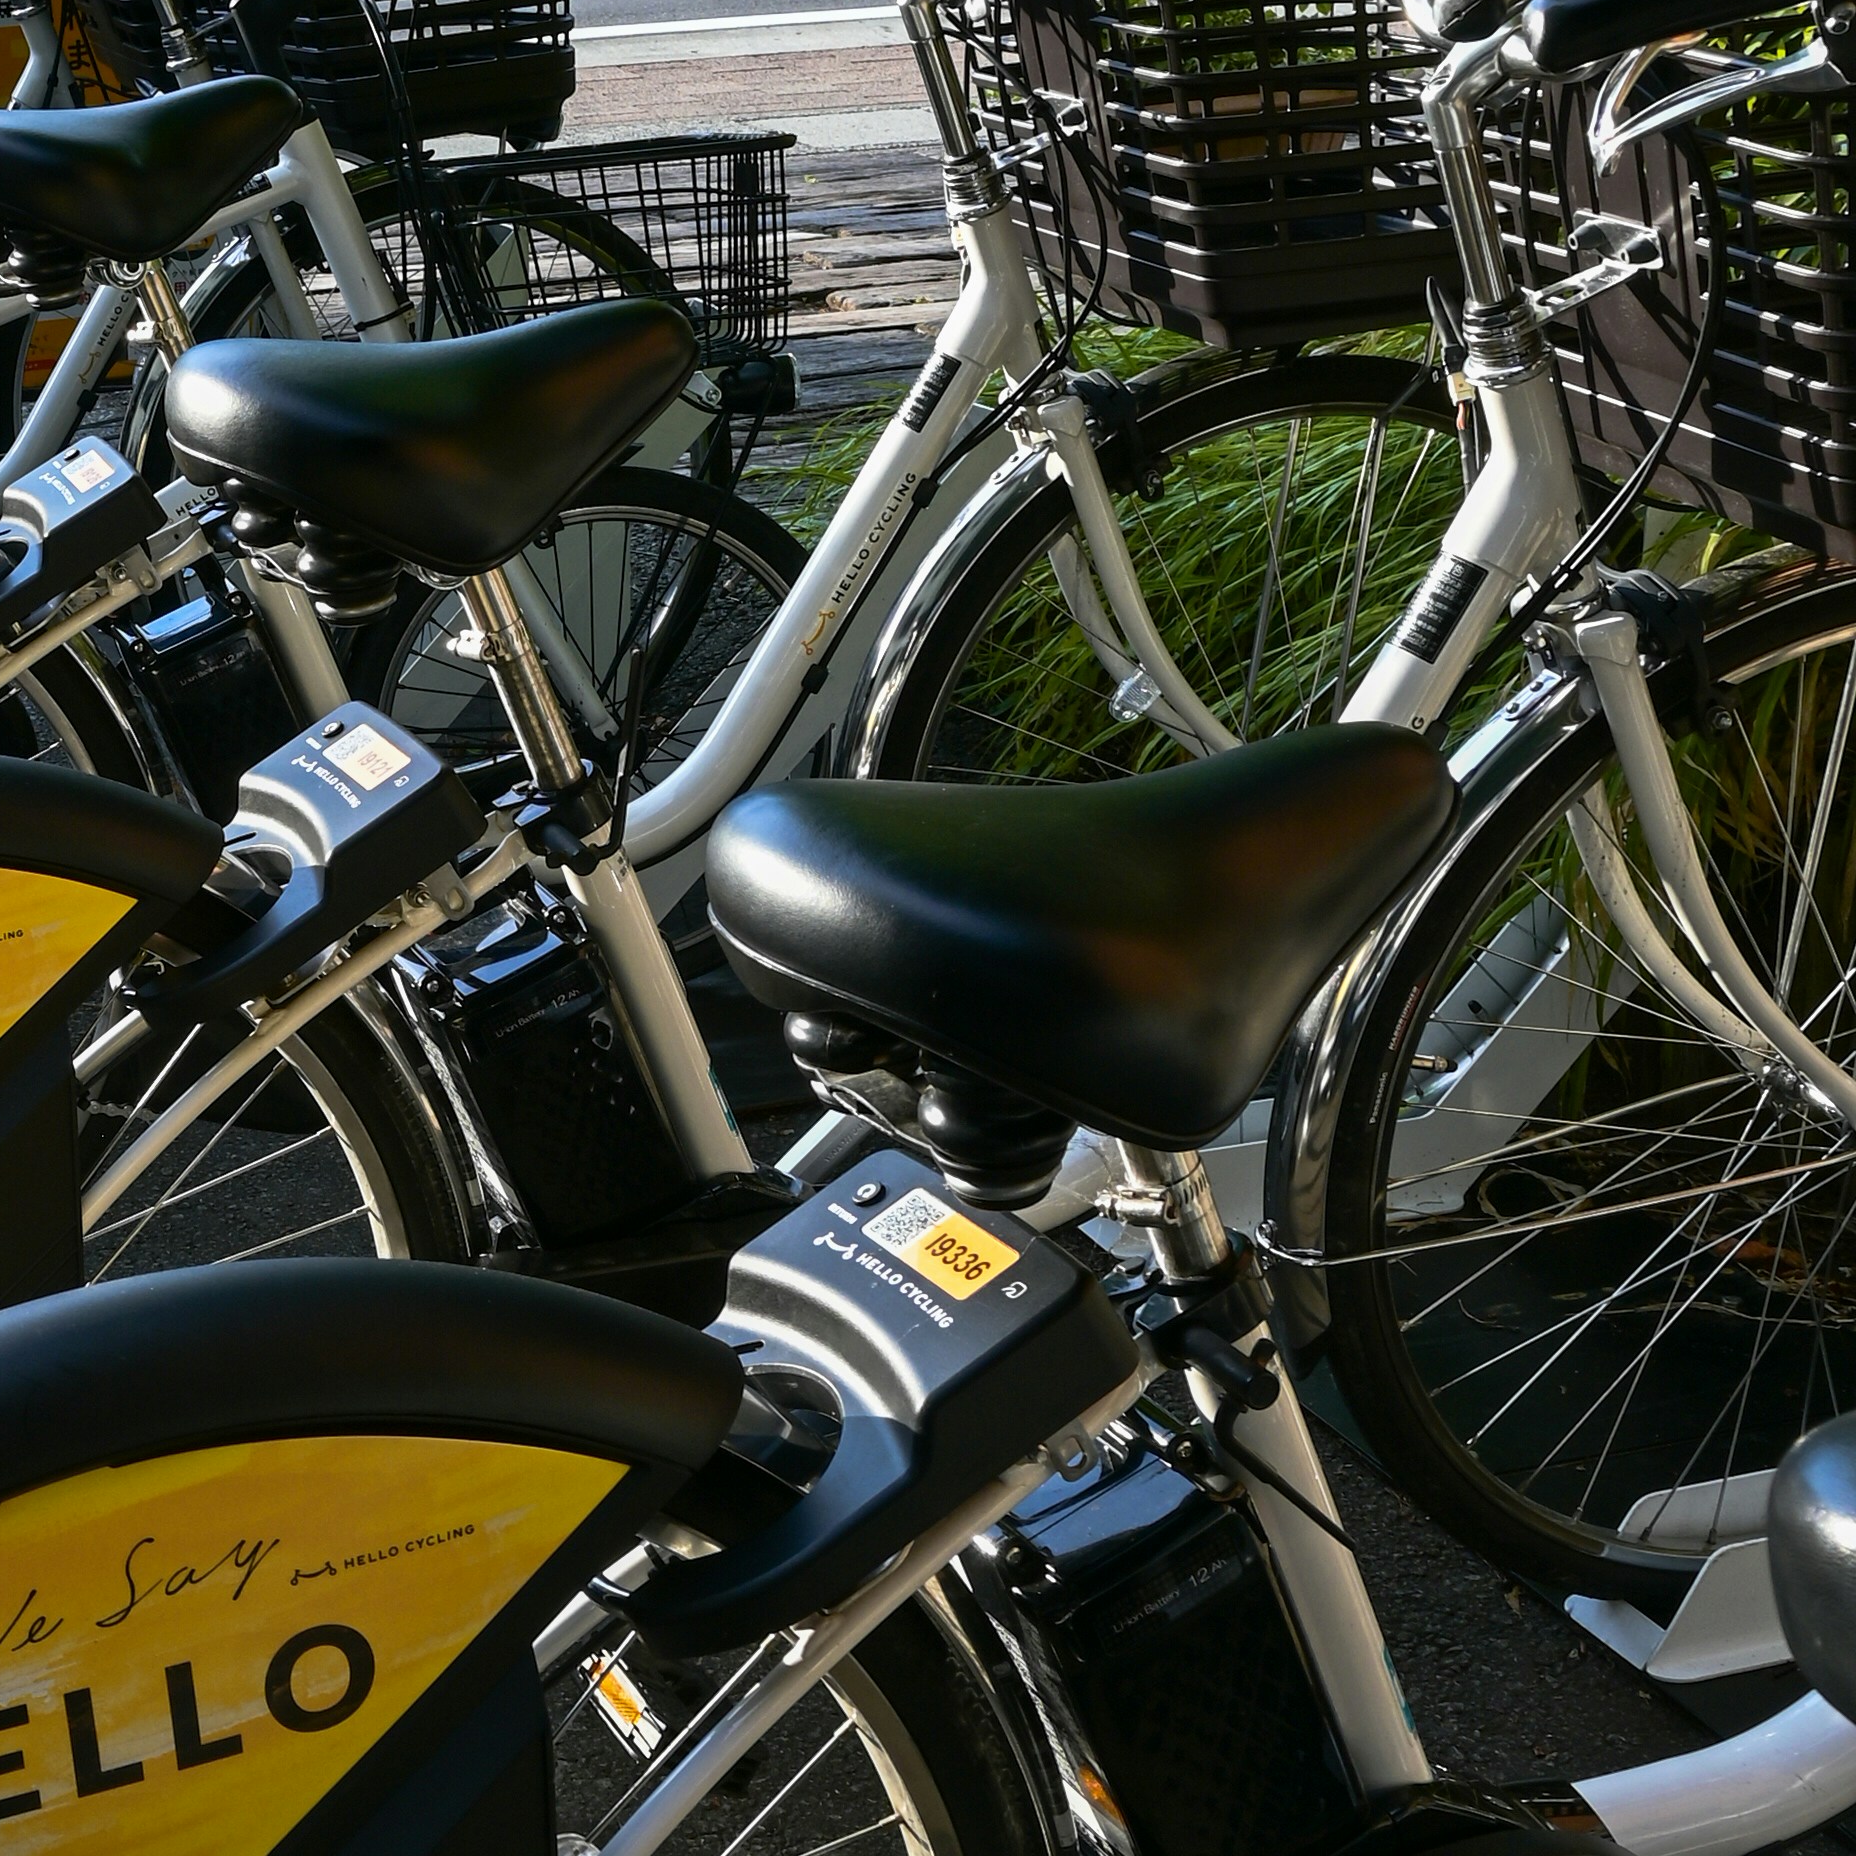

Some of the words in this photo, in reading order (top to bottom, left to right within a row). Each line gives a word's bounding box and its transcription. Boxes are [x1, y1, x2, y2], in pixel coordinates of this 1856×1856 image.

[97, 304, 123, 347] HELLO
[174, 486, 217, 518] HELLO
[831, 547, 870, 604] HELLO
[868, 471, 917, 545] CYCLING
[315, 765, 340, 789] HELLO
[334, 780, 362, 809] CYCLING
[357, 750, 392, 780] 19121
[923, 1233, 992, 1282] 19336
[855, 1252, 904, 1287] HELLO
[899, 1281, 955, 1330] CYCLING
[343, 1542, 401, 1571] HELLO
[404, 1522, 477, 1556] CYCLING
[95, 1536, 281, 1630] Say
